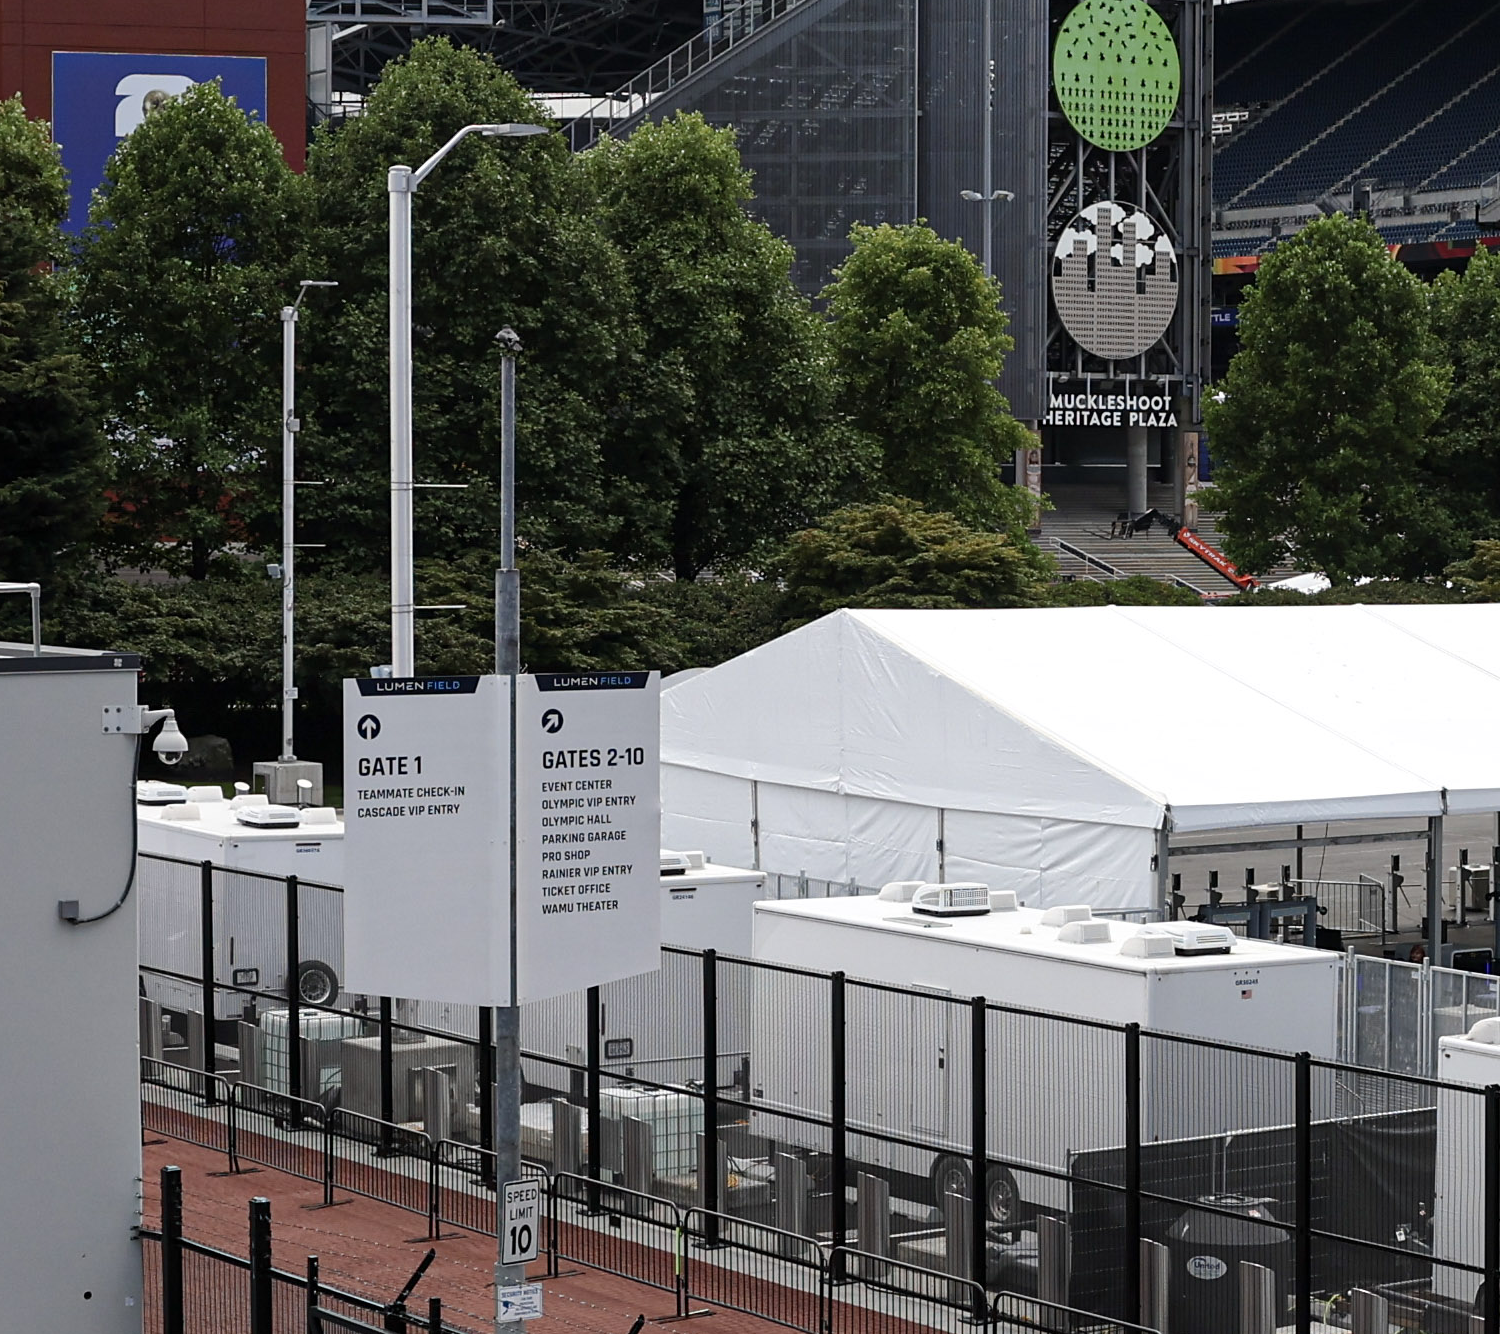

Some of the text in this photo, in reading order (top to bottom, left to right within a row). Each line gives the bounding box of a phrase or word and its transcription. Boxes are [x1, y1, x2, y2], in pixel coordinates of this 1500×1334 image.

[1050, 394, 1172, 411] MUCKLESHOOT
[1043, 411, 1178, 427] HERITAGE PLAZA
[376, 681, 460, 692] LUMEN FIELD
[554, 676, 632, 688] LUMEN FIELD
[543, 747, 644, 770] GATES 2-10
[358, 756, 422, 777] GATE 1
[357, 785, 465, 801] TEAMMATE CHECK-IN
[542, 779, 612, 792] EVENT CENTER
[542, 795, 636, 810] OLYMPIC VIP ENTRY
[357, 803, 460, 818] CASCADE VIP ENTRY
[542, 814, 612, 827] OLYMPIC HALL
[542, 830, 627, 845] PARKING GARAGE
[542, 849, 591, 862] PRO SHOP
[542, 865, 633, 880] RAINIER VIP ENTRY
[542, 883, 611, 897] TICKET OFFICE
[542, 900, 619, 914] WAMU THEATER
[507, 1188, 537, 1203] SPEED
[509, 1206, 533, 1221] LIMIT
[510, 1225, 531, 1255] 10
